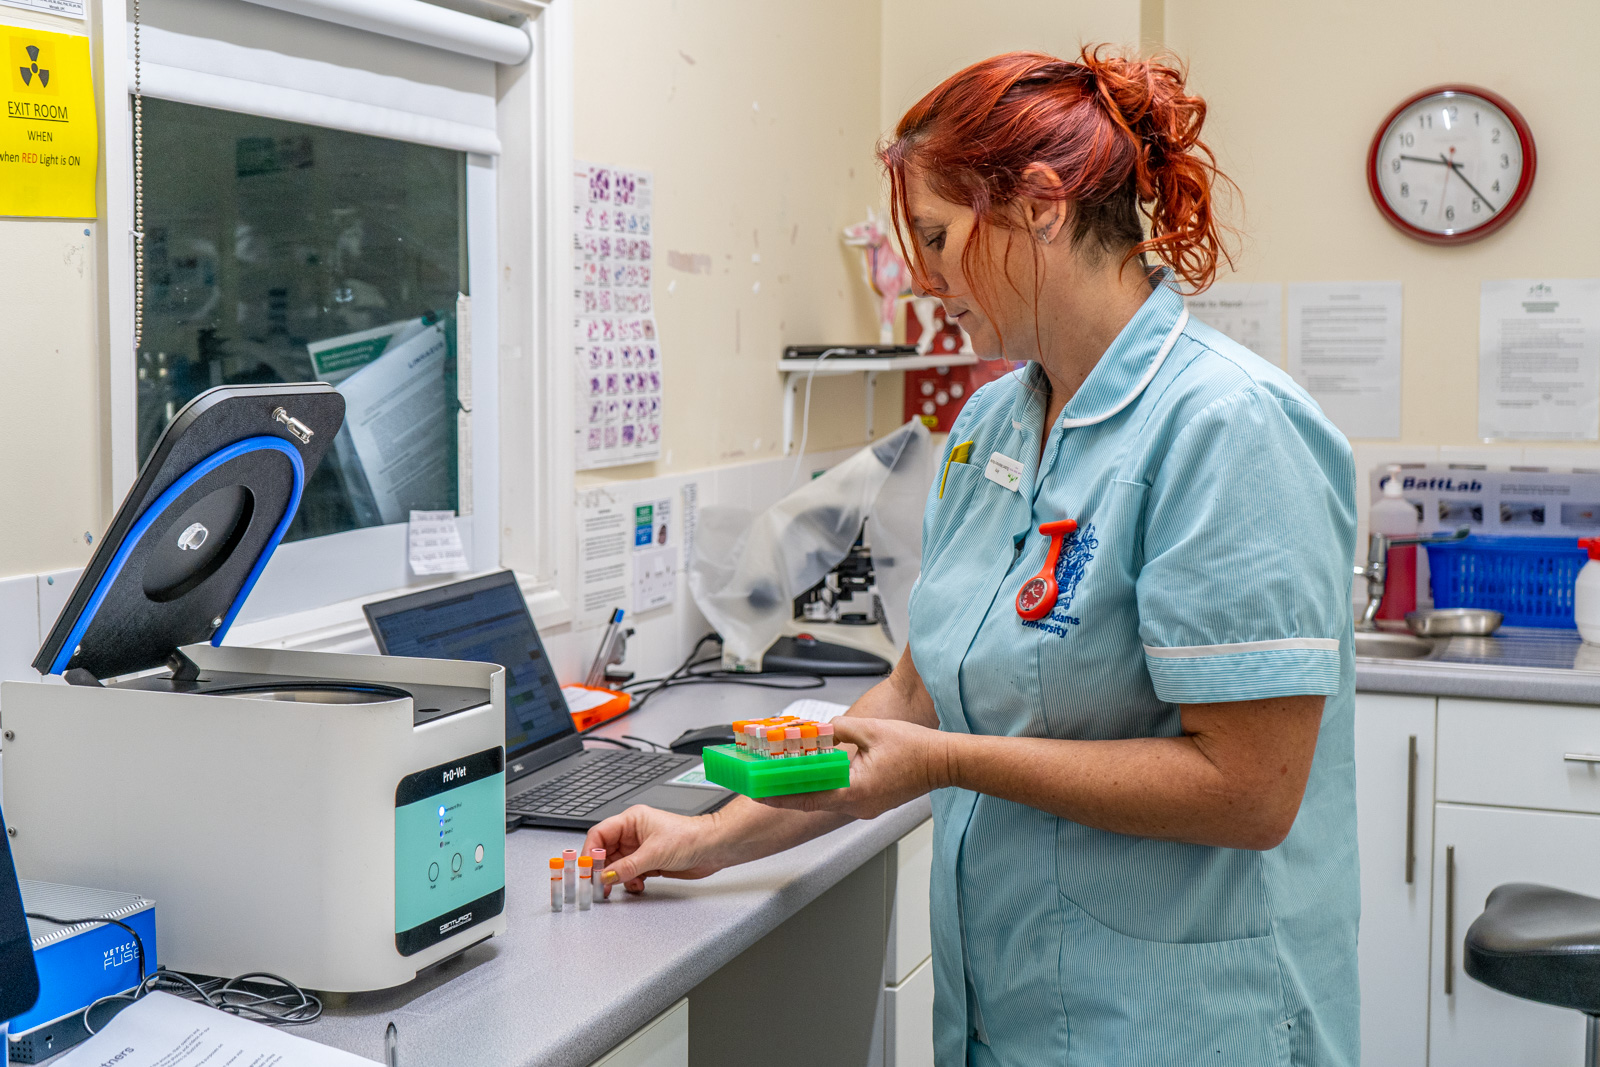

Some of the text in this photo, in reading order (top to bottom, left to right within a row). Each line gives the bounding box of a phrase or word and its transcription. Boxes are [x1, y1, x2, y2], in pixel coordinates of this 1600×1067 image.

[8, 101, 68, 119] EXIT ROOM
[27, 130, 53, 142] WHEN
[1400, 133, 1414, 147] 10
[22, 152, 38, 164] RED
[40, 153, 59, 167] Light
[60, 155, 67, 166] is
[68, 155, 80, 166] ON
[1500, 153, 1509, 169] 3
[1446, 206, 1454, 221] 6
[1403, 476, 1483, 493] BattLab
[104, 940, 139, 958] VETSCA
[104, 947, 140, 970] FUSE
